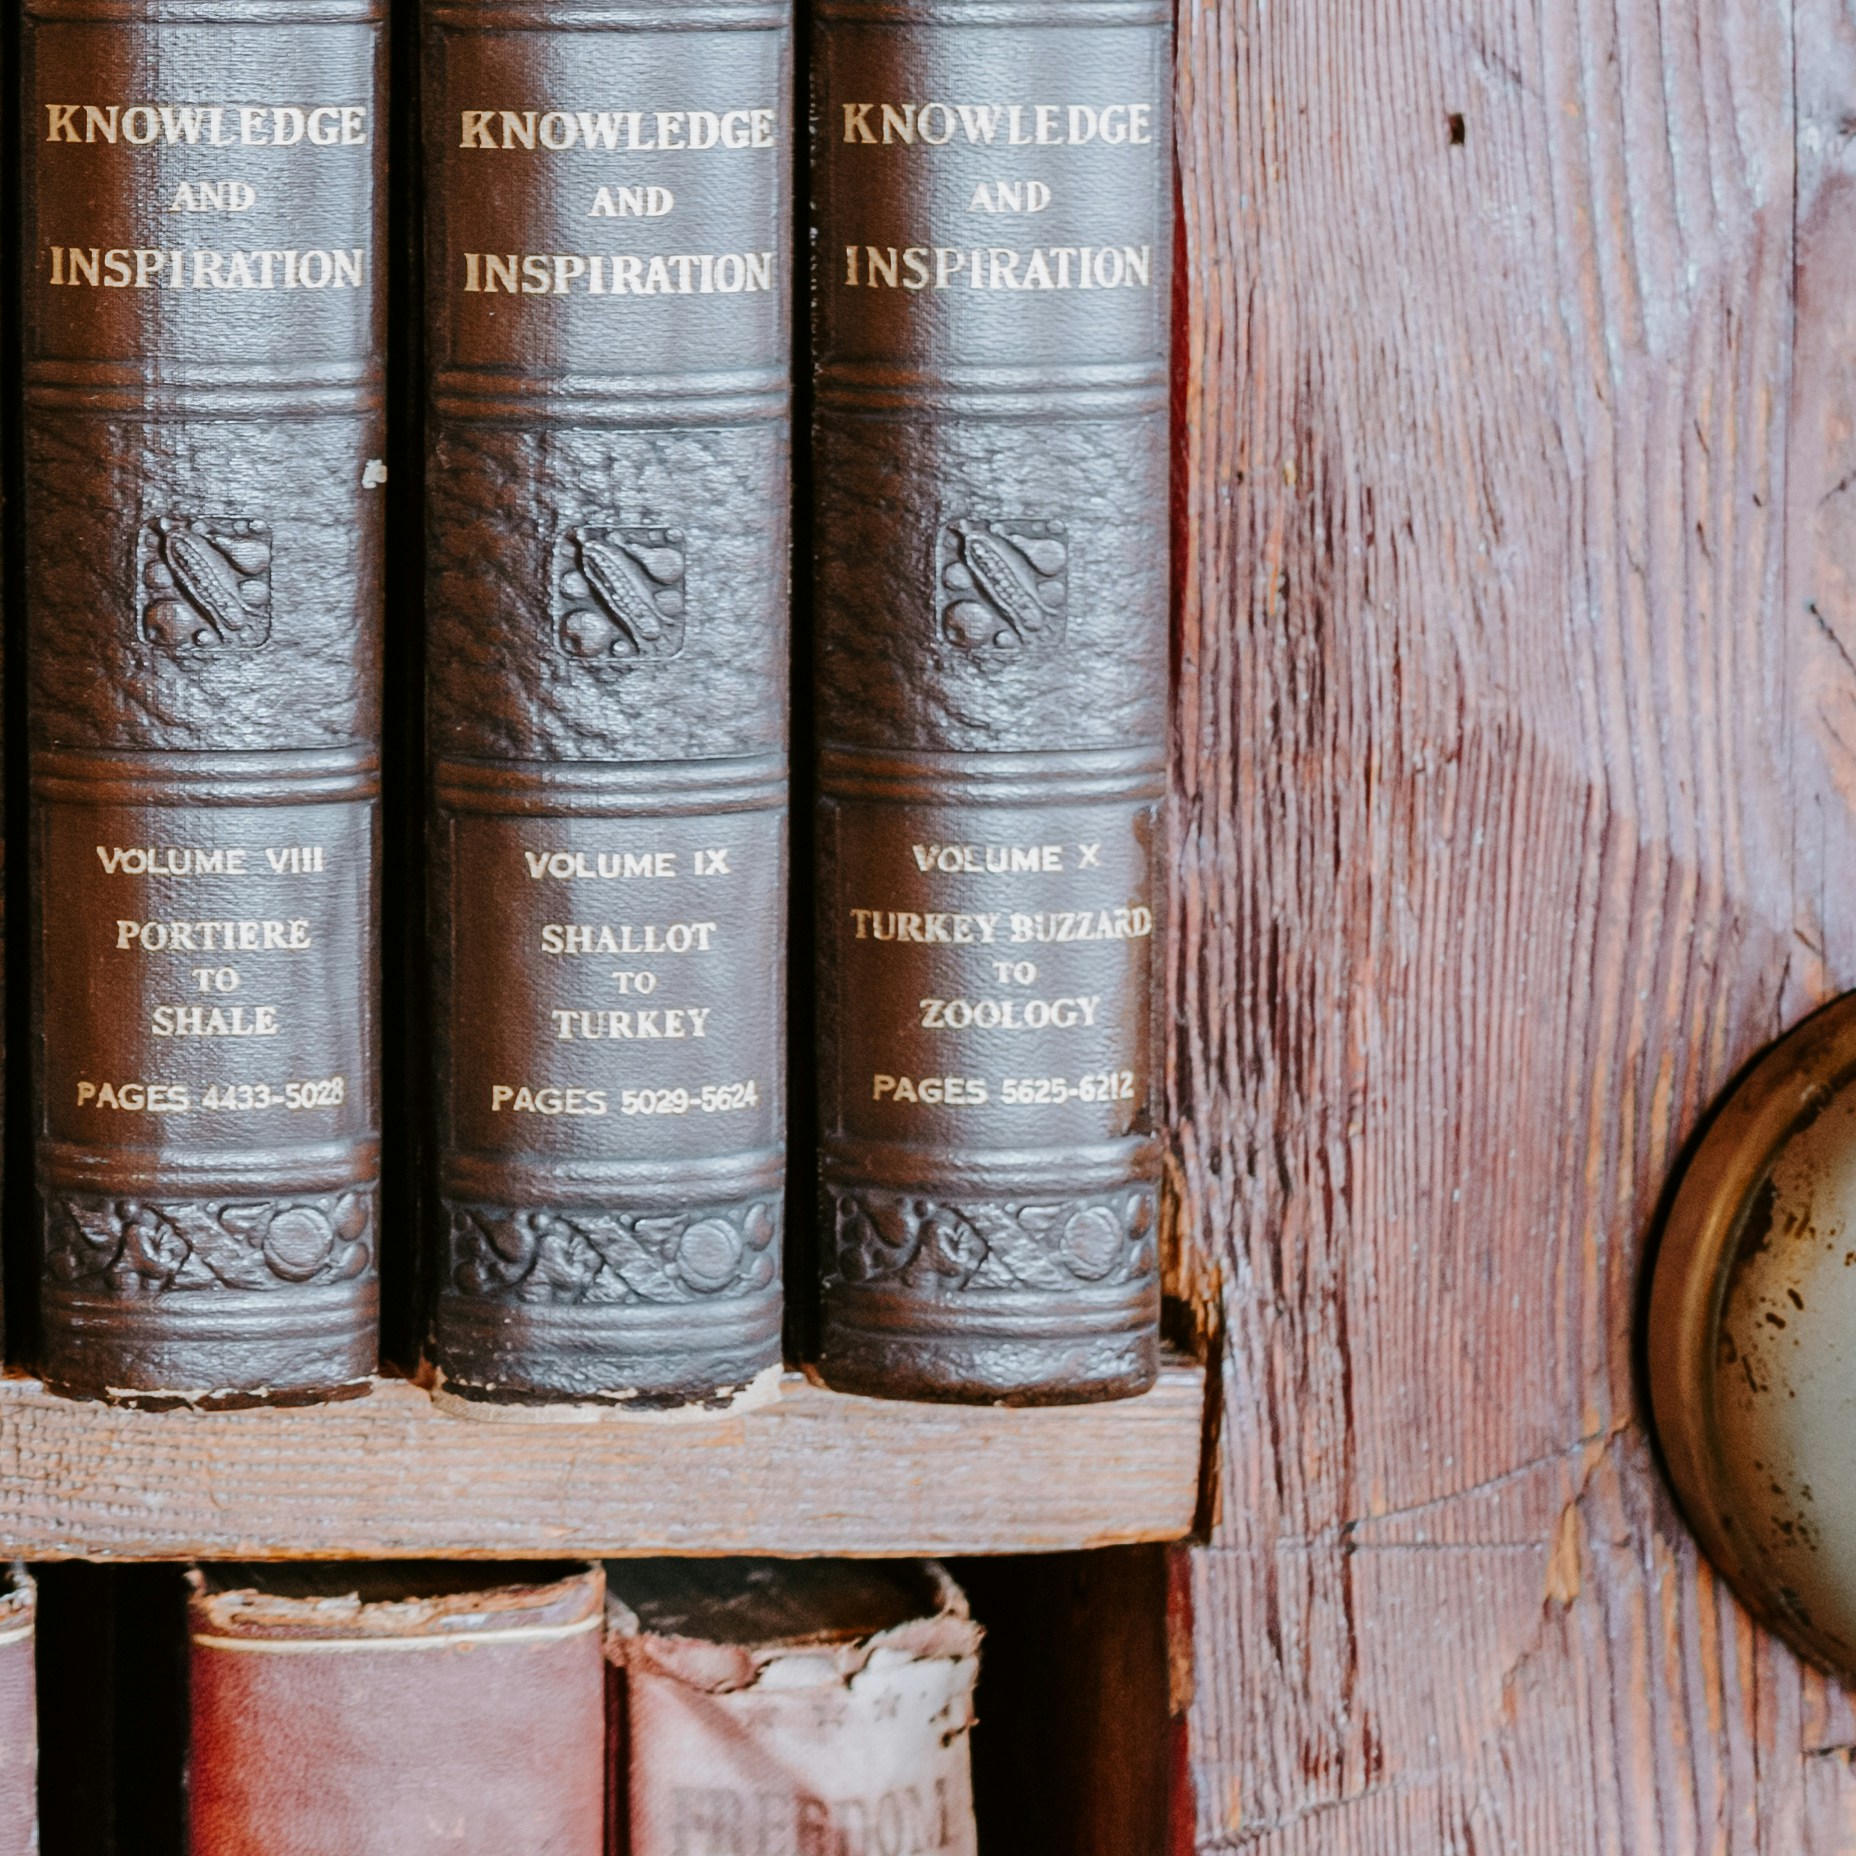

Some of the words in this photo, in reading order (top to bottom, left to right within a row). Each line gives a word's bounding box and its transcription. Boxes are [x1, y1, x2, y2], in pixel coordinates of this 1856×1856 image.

[45, 103, 366, 146] KNOWLEDGE
[460, 109, 776, 149] KNOWLEDGE
[842, 102, 1150, 146] KNOWLEDGE
[50, 246, 364, 289] INSPIRATION
[463, 251, 772, 294] INSPIRATION
[845, 245, 1150, 290] INSPIRATION
[97, 846, 246, 875] VOLUME
[265, 846, 324, 874] VIII
[525, 850, 676, 879] VOLUME
[694, 849, 730, 875] IX
[913, 844, 1061, 873] VOLUME
[1077, 843, 1101, 869] X
[116, 920, 312, 951] PORTIERE
[541, 922, 716, 955] SHALLOT
[850, 908, 998, 943] TURKEY
[1010, 906, 1152, 942] BUZZARD
[151, 1007, 280, 1036] SHALE
[551, 1008, 711, 1040] TURKEY
[920, 997, 1101, 1028] ZOOLOGY
[77, 1080, 190, 1112] PAGES
[202, 1077, 346, 1111] 4433-5028
[492, 1085, 607, 1115] PAGES
[620, 1080, 757, 1115] 5029-5624
[873, 1073, 987, 1105] PAGES
[1000, 1070, 1134, 1104] 5625-6212
